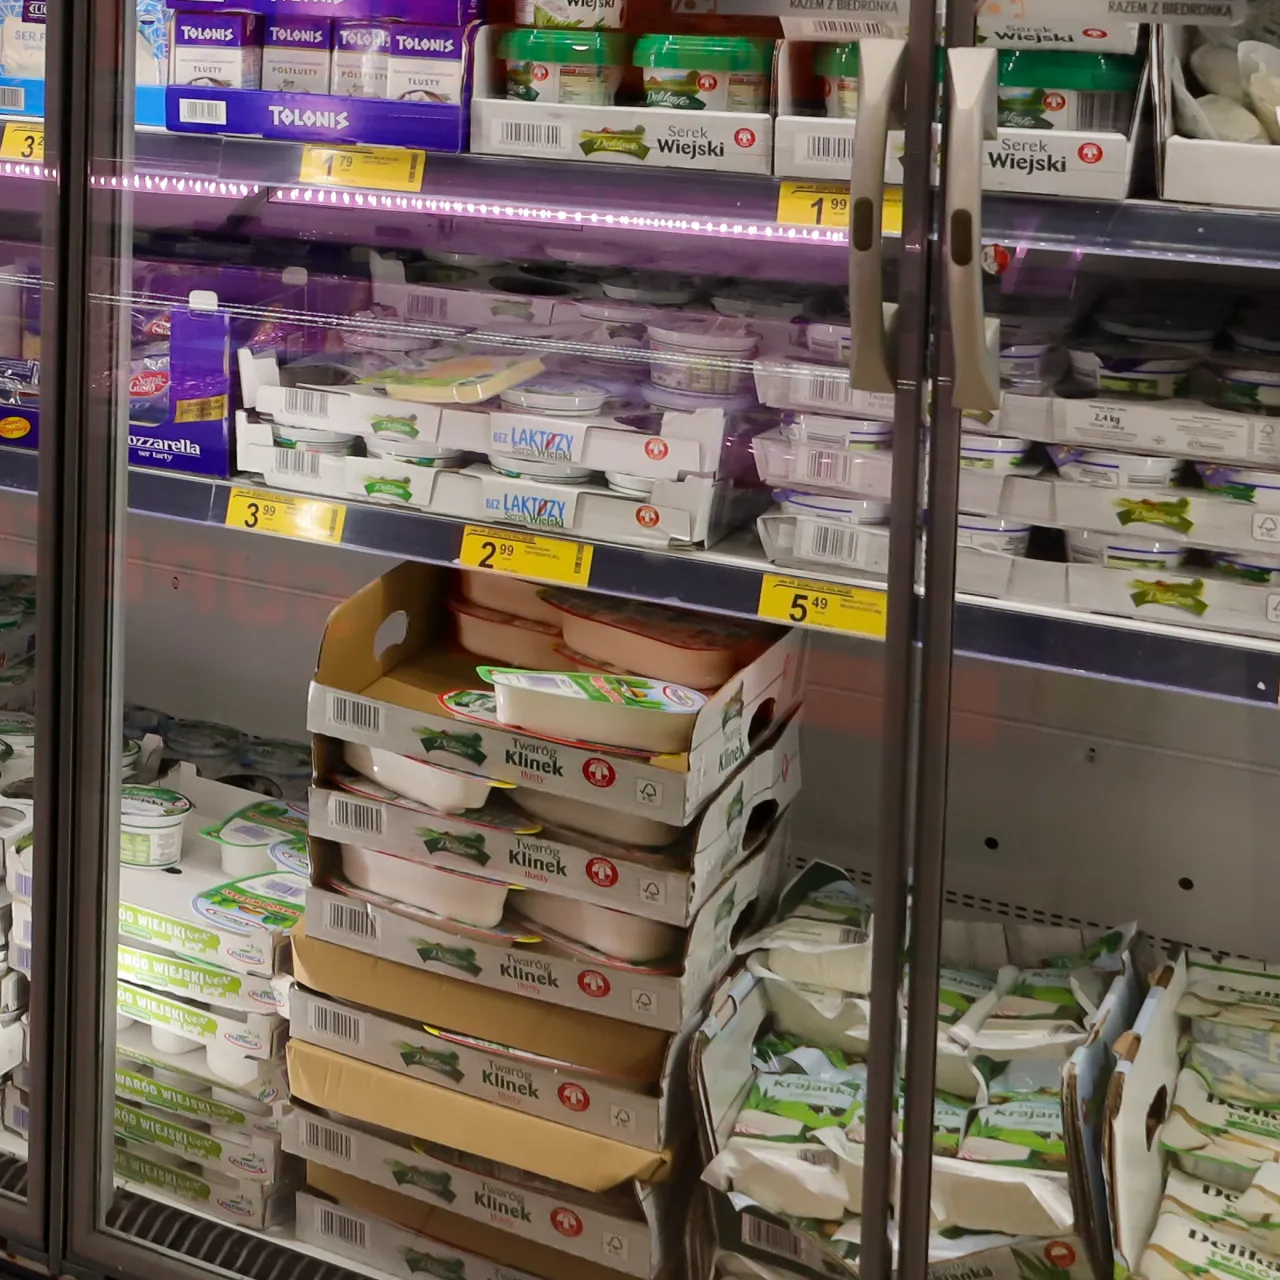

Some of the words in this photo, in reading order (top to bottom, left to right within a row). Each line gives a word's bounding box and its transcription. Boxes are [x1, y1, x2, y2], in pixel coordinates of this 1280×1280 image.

[269, 106, 348, 129] TOLONIS
[658, 138, 724, 157] Wiejski
[988, 153, 1066, 174] Wiejski
[810, 198, 822, 224] 1
[831, 199, 846, 210] 99
[245, 504, 258, 528] 3
[481, 544, 494, 568] 2
[499, 544, 513, 557] 99
[790, 594, 807, 622] 5
[811, 597, 828, 609] 49
[512, 738, 557, 761] Twaróg
[505, 747, 563, 779] Klinek
[516, 837, 559, 859] Twaróg
[509, 847, 566, 877] Klinek
[506, 951, 551, 974] Twaróg
[500, 962, 558, 990] Klinek
[481, 1070, 539, 1100] Klinek
[474, 1191, 532, 1223] Klinek
